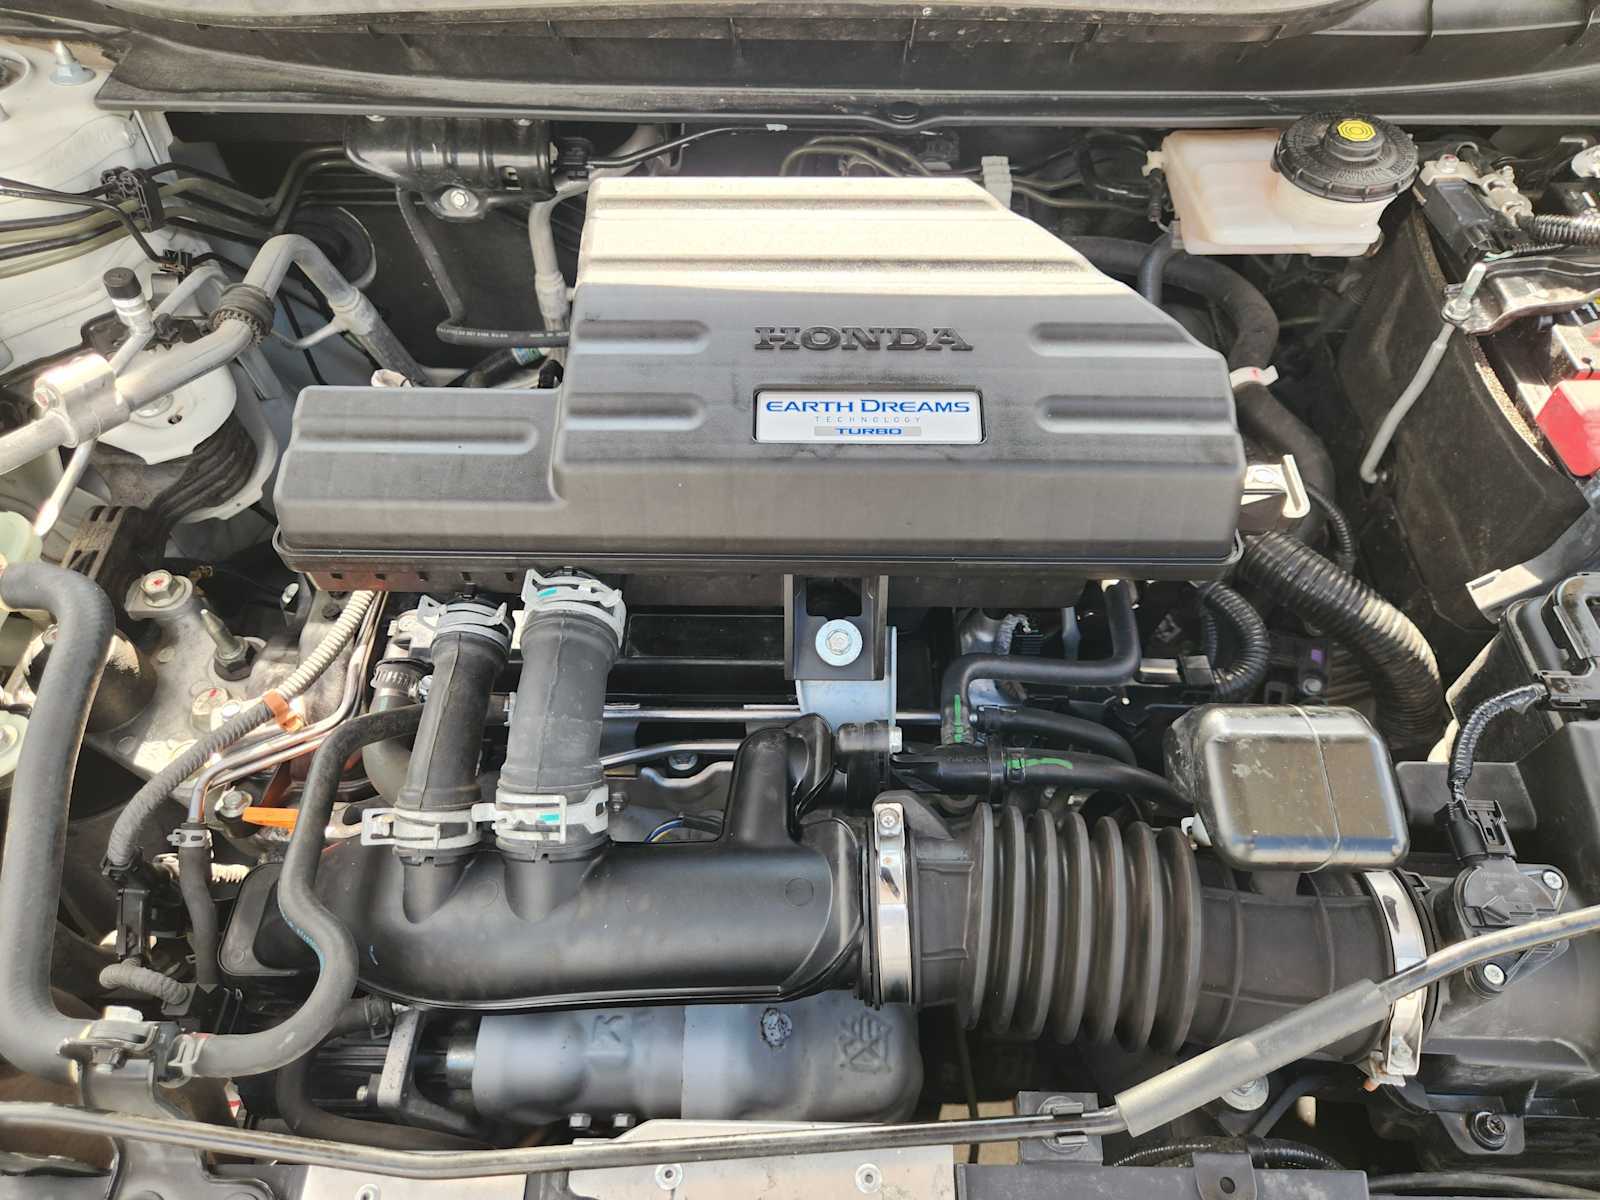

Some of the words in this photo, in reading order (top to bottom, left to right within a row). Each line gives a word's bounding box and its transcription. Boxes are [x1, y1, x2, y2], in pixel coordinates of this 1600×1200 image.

[754, 326, 974, 351] HONDA
[766, 401, 853, 412] EARTH
[861, 399, 970, 413] DREAMS
[835, 427, 901, 435] TURBO
